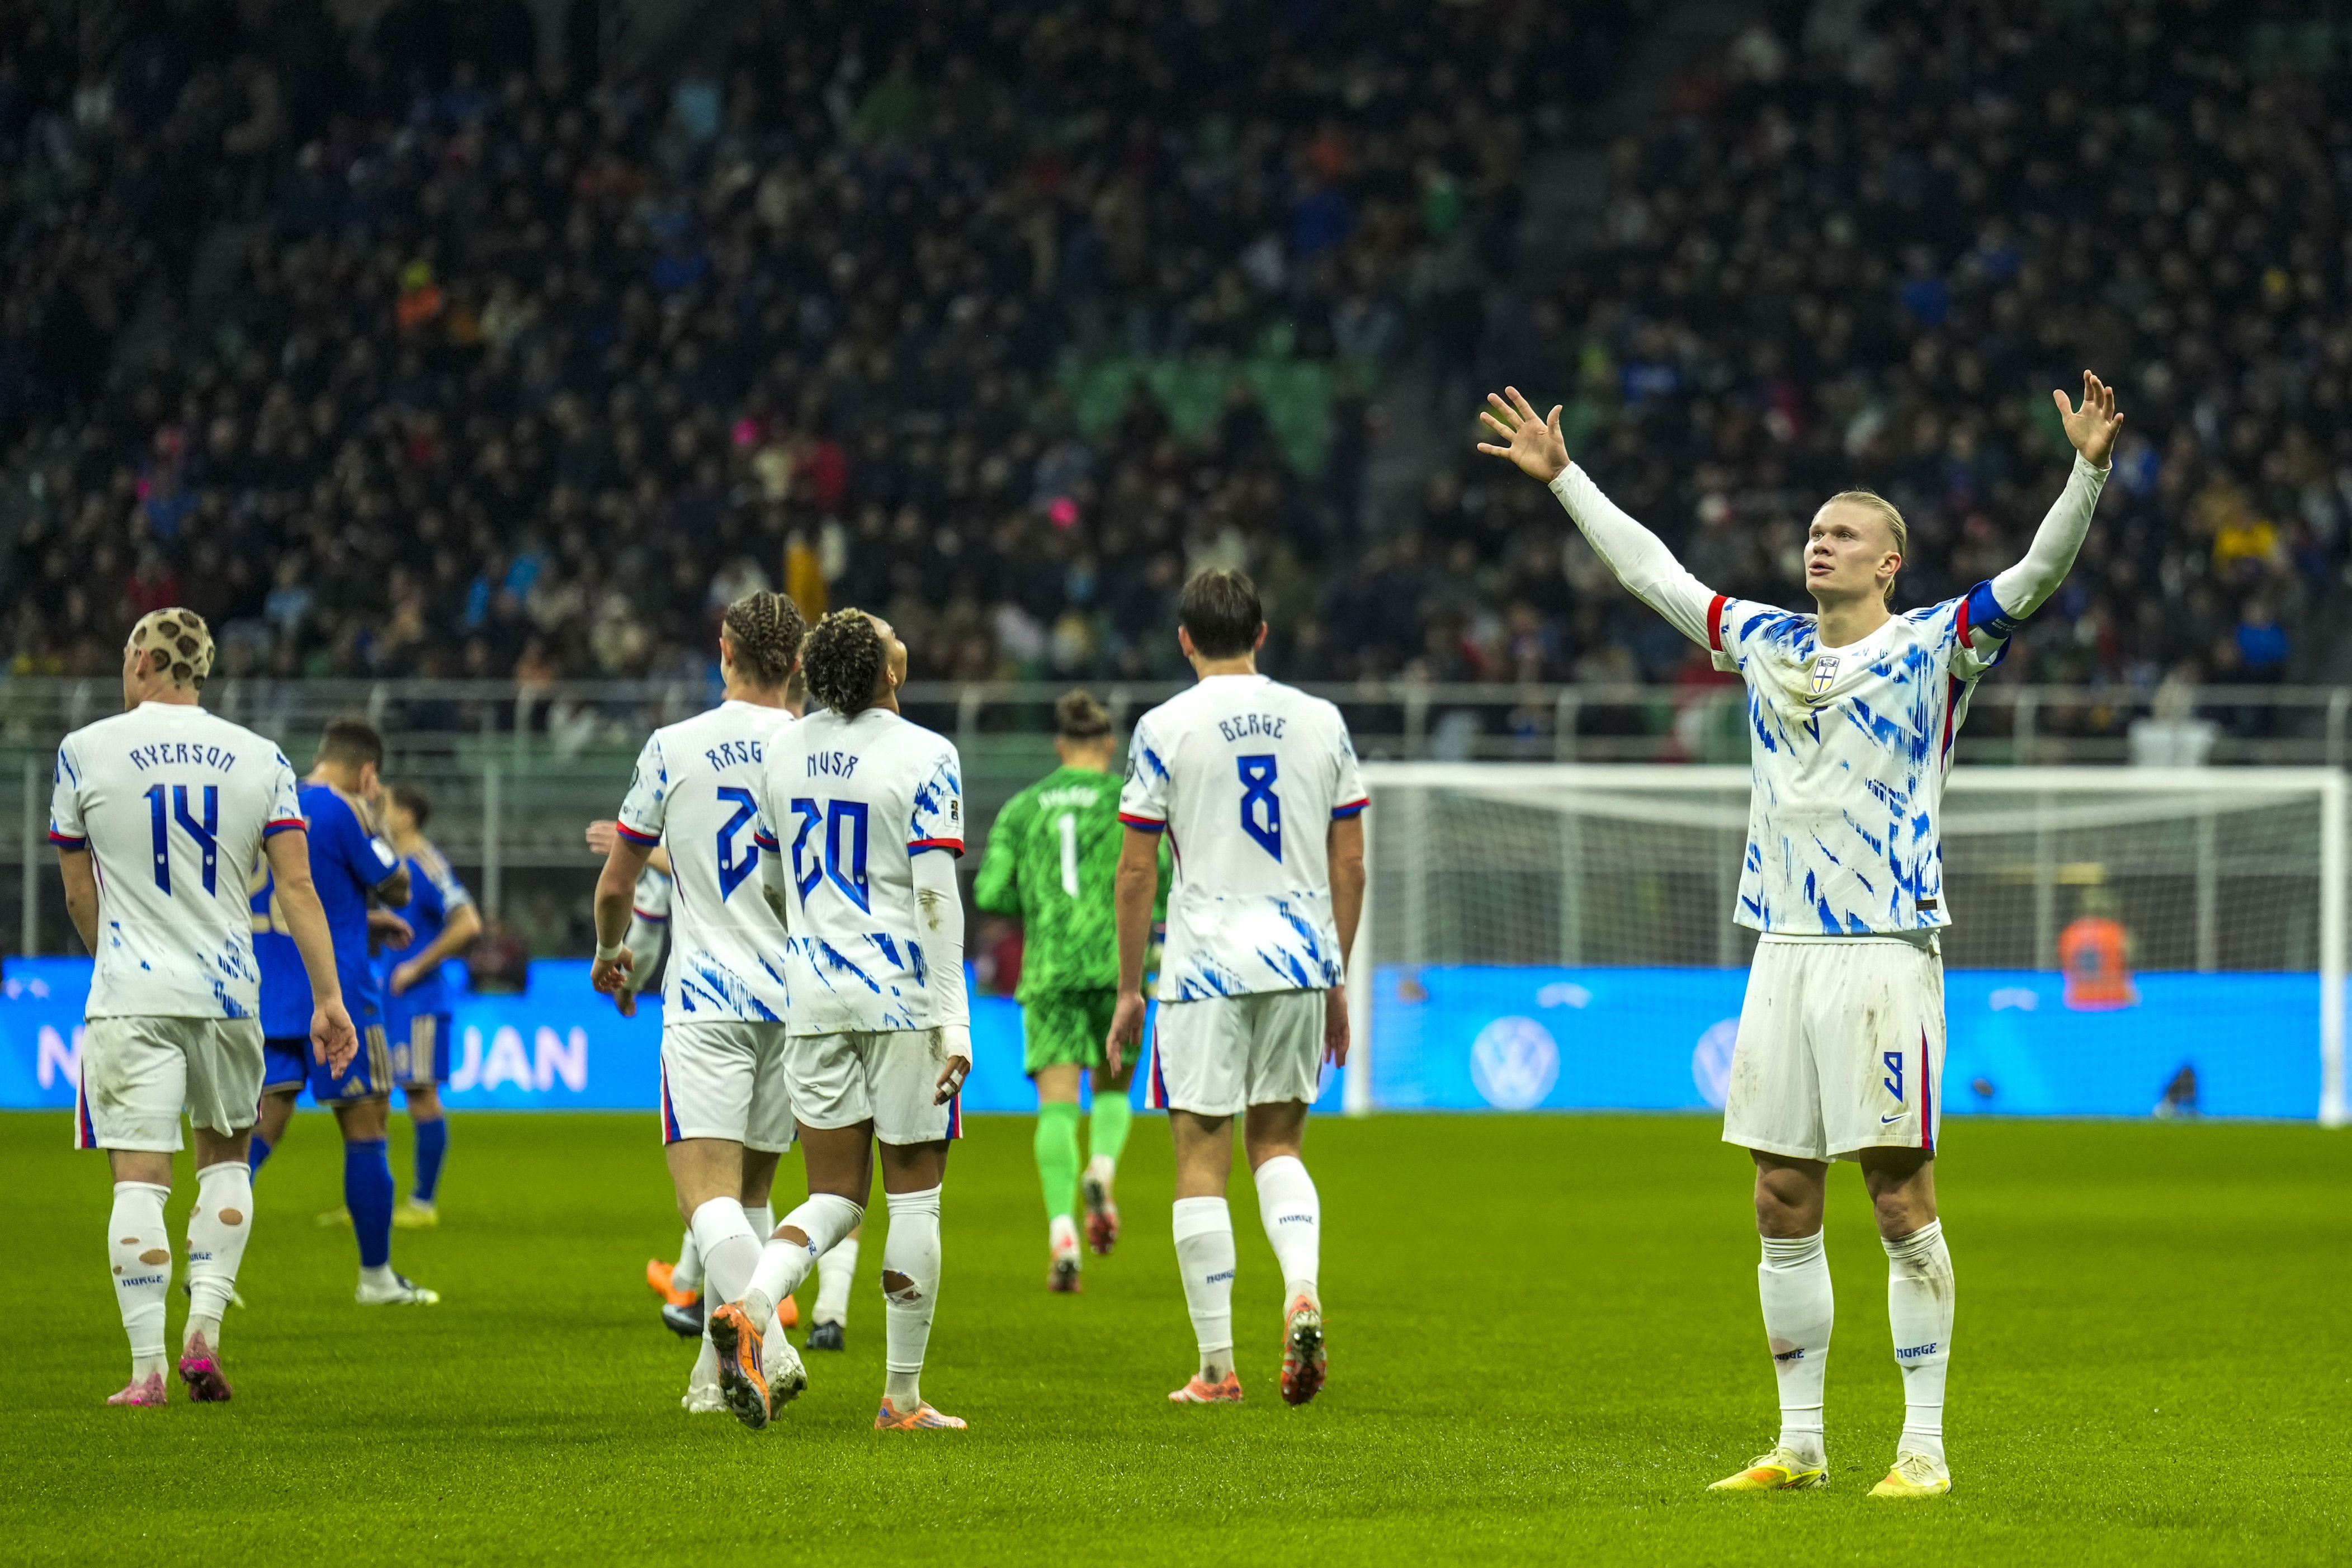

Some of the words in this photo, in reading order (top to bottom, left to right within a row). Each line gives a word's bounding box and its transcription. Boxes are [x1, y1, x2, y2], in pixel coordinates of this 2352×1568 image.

[1218, 714, 1286, 742] BERGE
[129, 743, 236, 773] RYERSON
[705, 741, 763, 772] AASG
[807, 751, 859, 780] NUSA
[1236, 754, 1282, 865] 8
[143, 784, 218, 900] 14
[716, 786, 758, 904] 2
[791, 797, 871, 917] 20
[1057, 813, 1080, 899] 1
[1883, 1051, 1903, 1103] 9
[1896, 1343, 1937, 1358] NORGE
